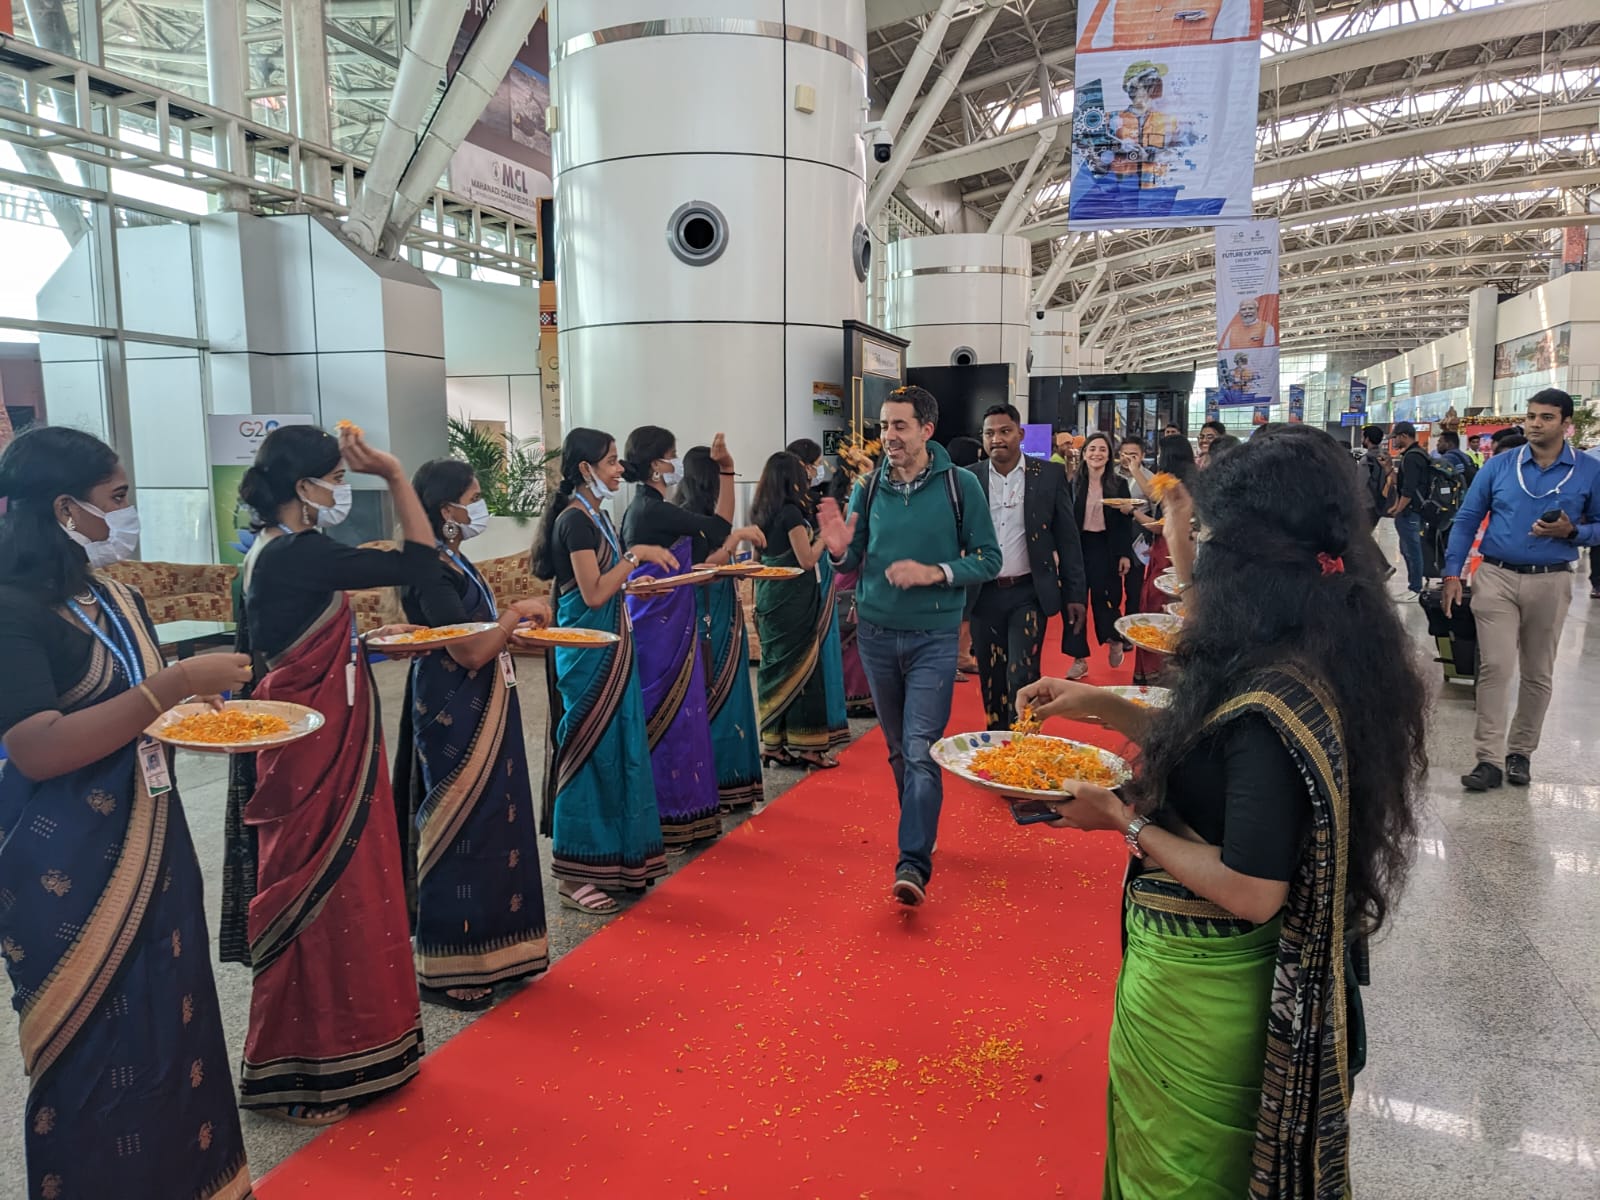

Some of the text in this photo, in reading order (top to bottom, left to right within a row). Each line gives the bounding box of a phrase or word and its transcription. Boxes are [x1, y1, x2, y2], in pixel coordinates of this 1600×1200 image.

[502, 163, 528, 194] MCL
[471, 179, 500, 196] MAHANADI
[500, 189, 529, 206] COALFIELDS
[1222, 251, 1243, 259] FUTURE
